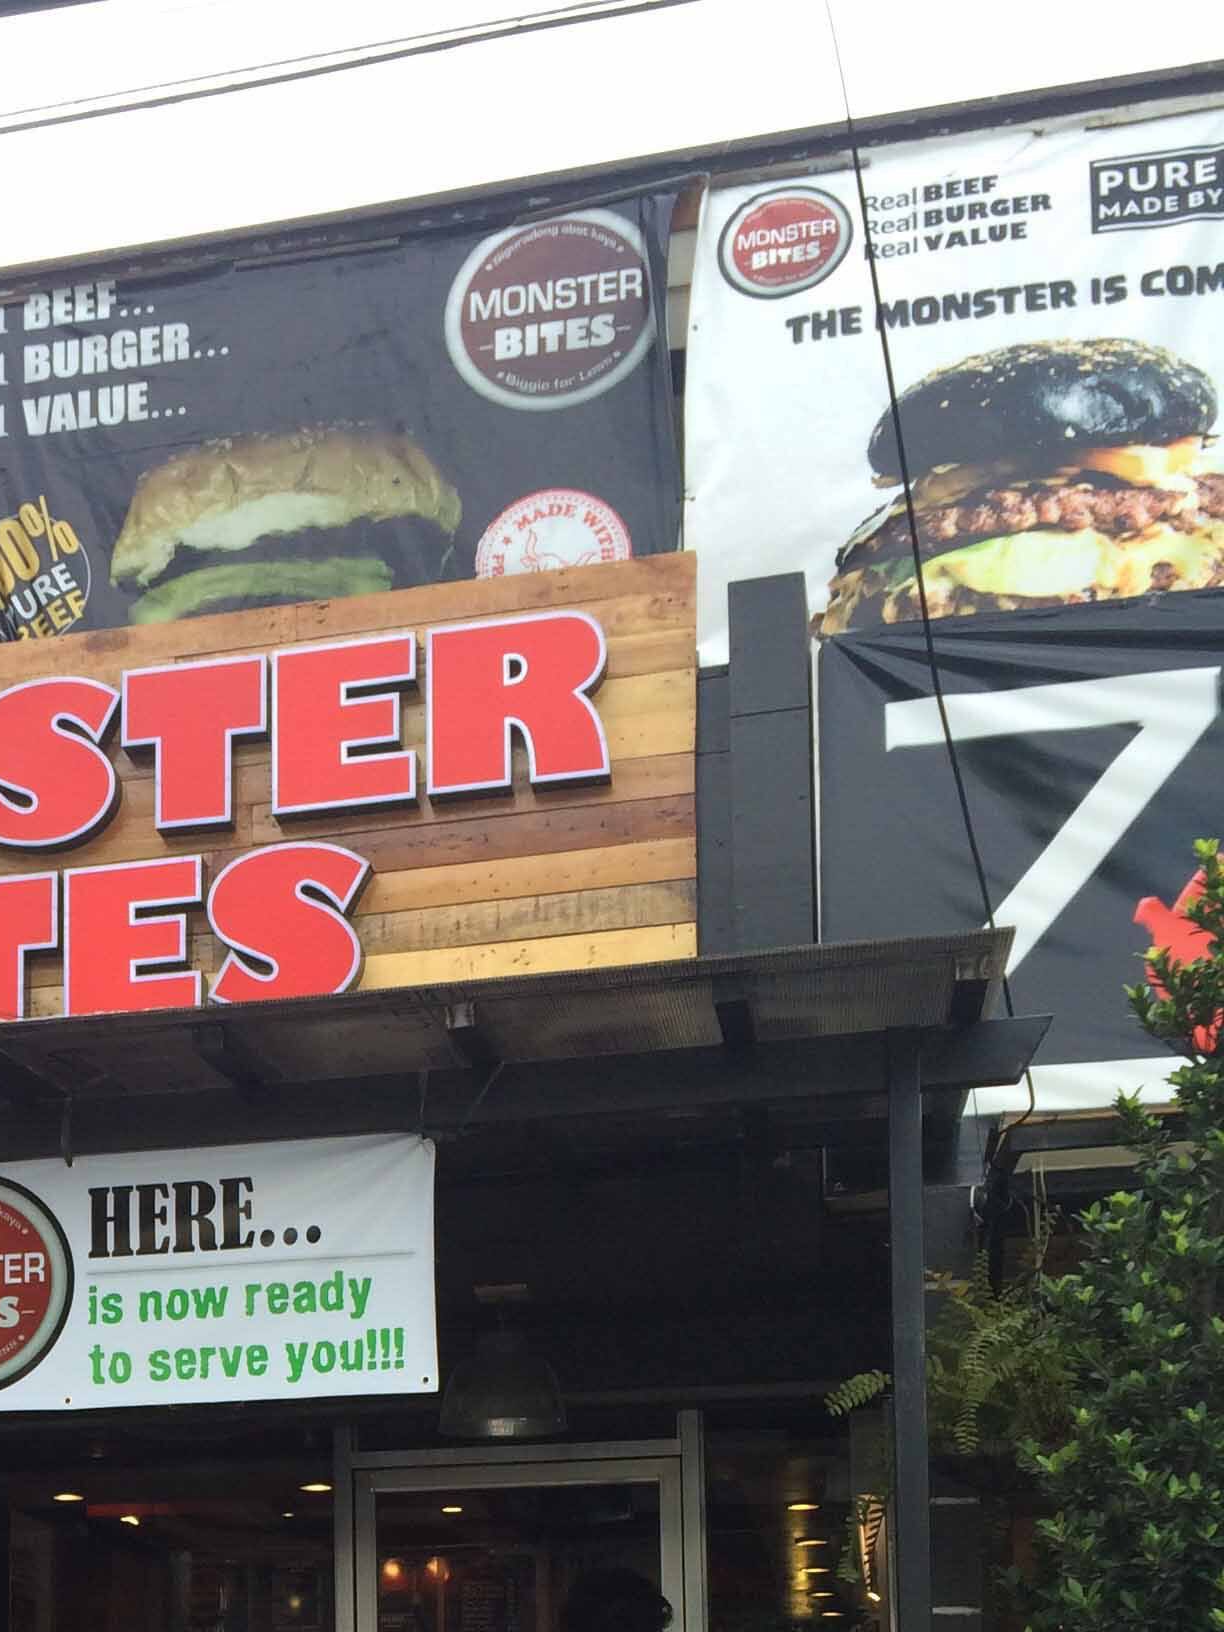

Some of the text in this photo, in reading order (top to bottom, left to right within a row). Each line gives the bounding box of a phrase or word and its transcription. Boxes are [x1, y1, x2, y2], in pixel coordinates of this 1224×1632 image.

[864, 175, 999, 213] Real BEEF
[1098, 157, 1218, 197] PURE
[865, 210, 919, 236] Real
[923, 194, 1053, 229] BURGER
[1098, 187, 1224, 220] MADE BY
[737, 219, 836, 252] MONSTER
[751, 240, 821, 271] BITES
[863, 221, 1028, 261] Real VALUE
[23, 280, 155, 332] BEEF...
[468, 267, 643, 323] MONSTER
[785, 305, 863, 344] THE
[875, 279, 1077, 330] MONSTER
[1090, 274, 1128, 305] IS
[23, 323, 230, 385] BURGER...
[494, 313, 616, 361] BITES
[22, 381, 187, 437] VALUE...
[514, 503, 615, 561] MADE WITH
[87, 1176, 322, 1259] HERE...
[88, 1270, 372, 1325] is now ready
[88, 1326, 405, 1385] to serve you!!!
